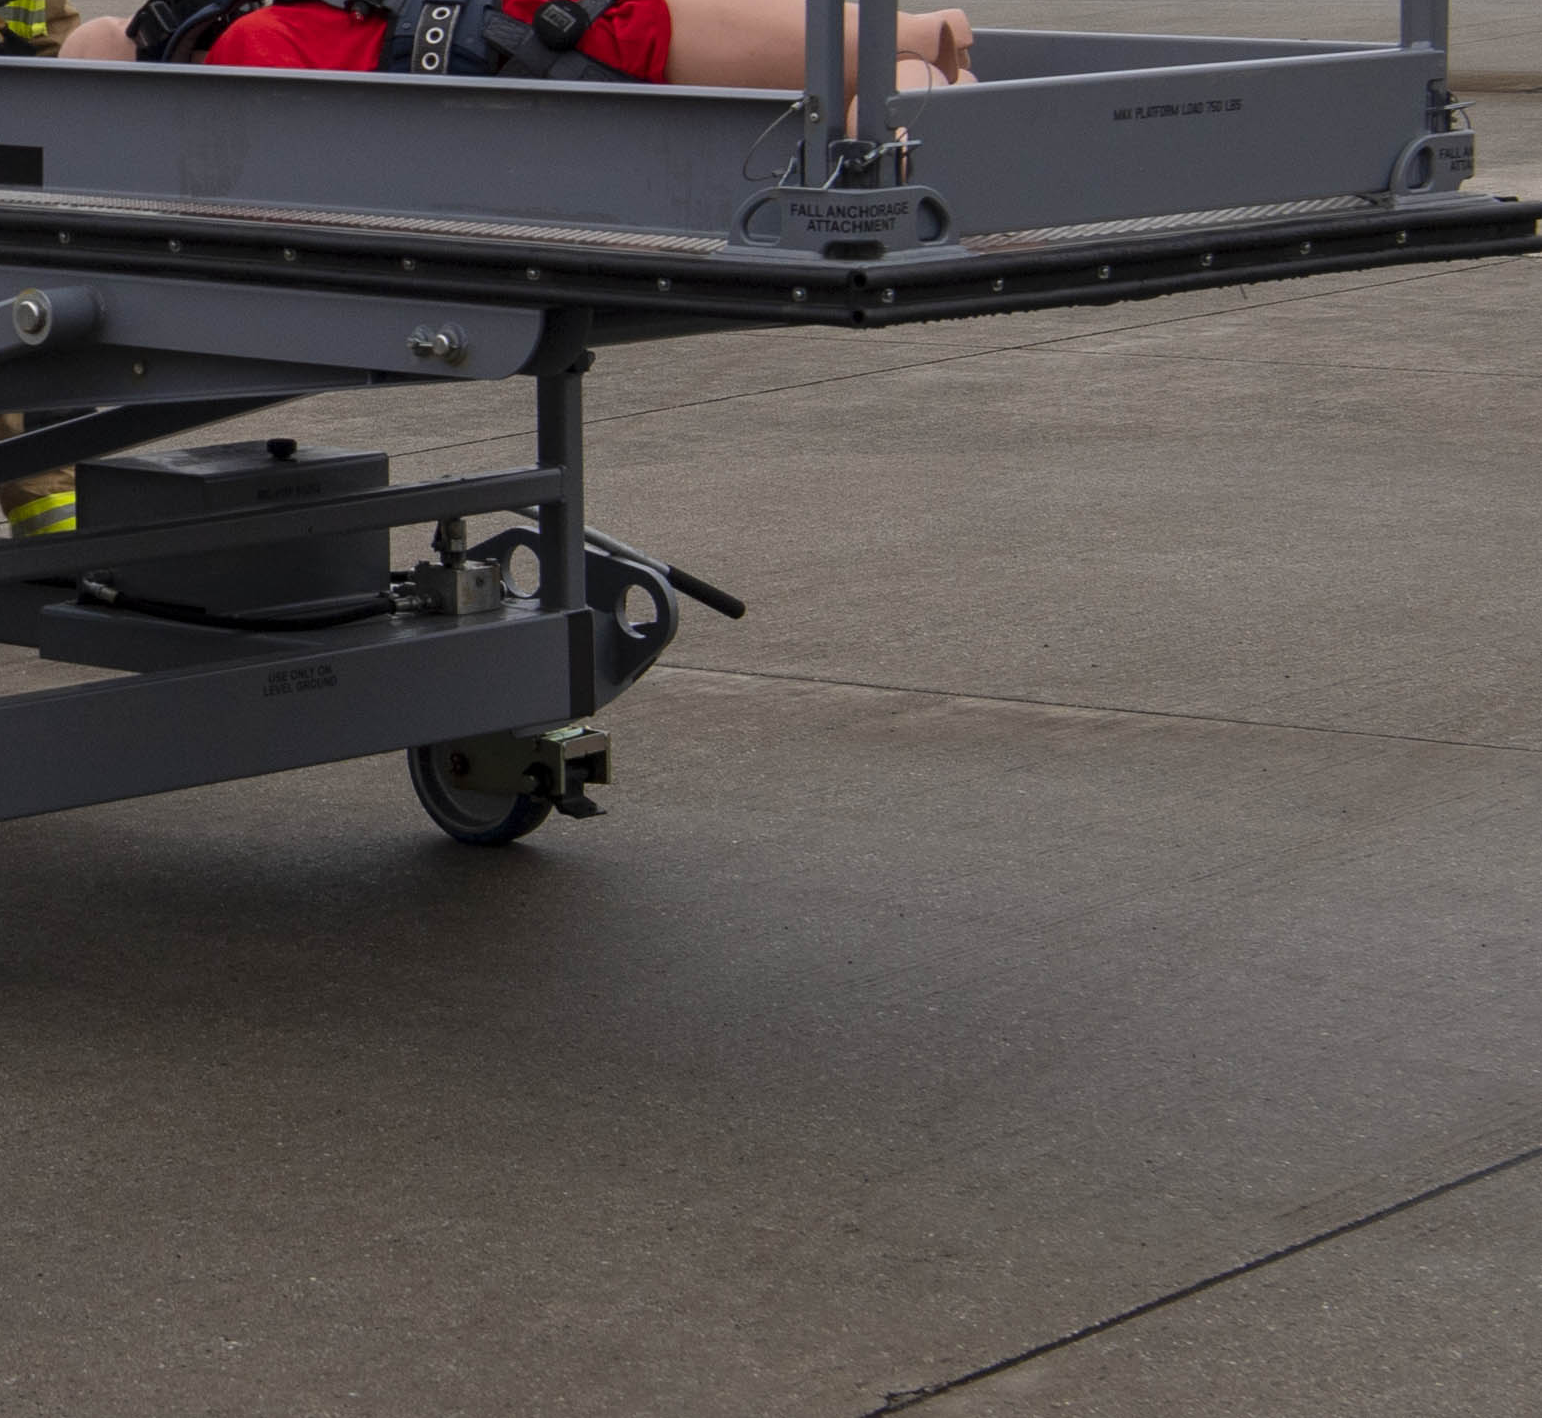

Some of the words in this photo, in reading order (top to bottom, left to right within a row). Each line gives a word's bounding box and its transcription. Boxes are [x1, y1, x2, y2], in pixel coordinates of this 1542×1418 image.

[790, 203, 822, 218] FALL
[825, 201, 909, 218] ANCHORAGE
[806, 218, 896, 233] ATTACHMENT
[268, 668, 288, 683] USE
[290, 667, 315, 681] ONLY
[263, 683, 292, 696] LEVEL
[296, 675, 338, 692] GROUND
